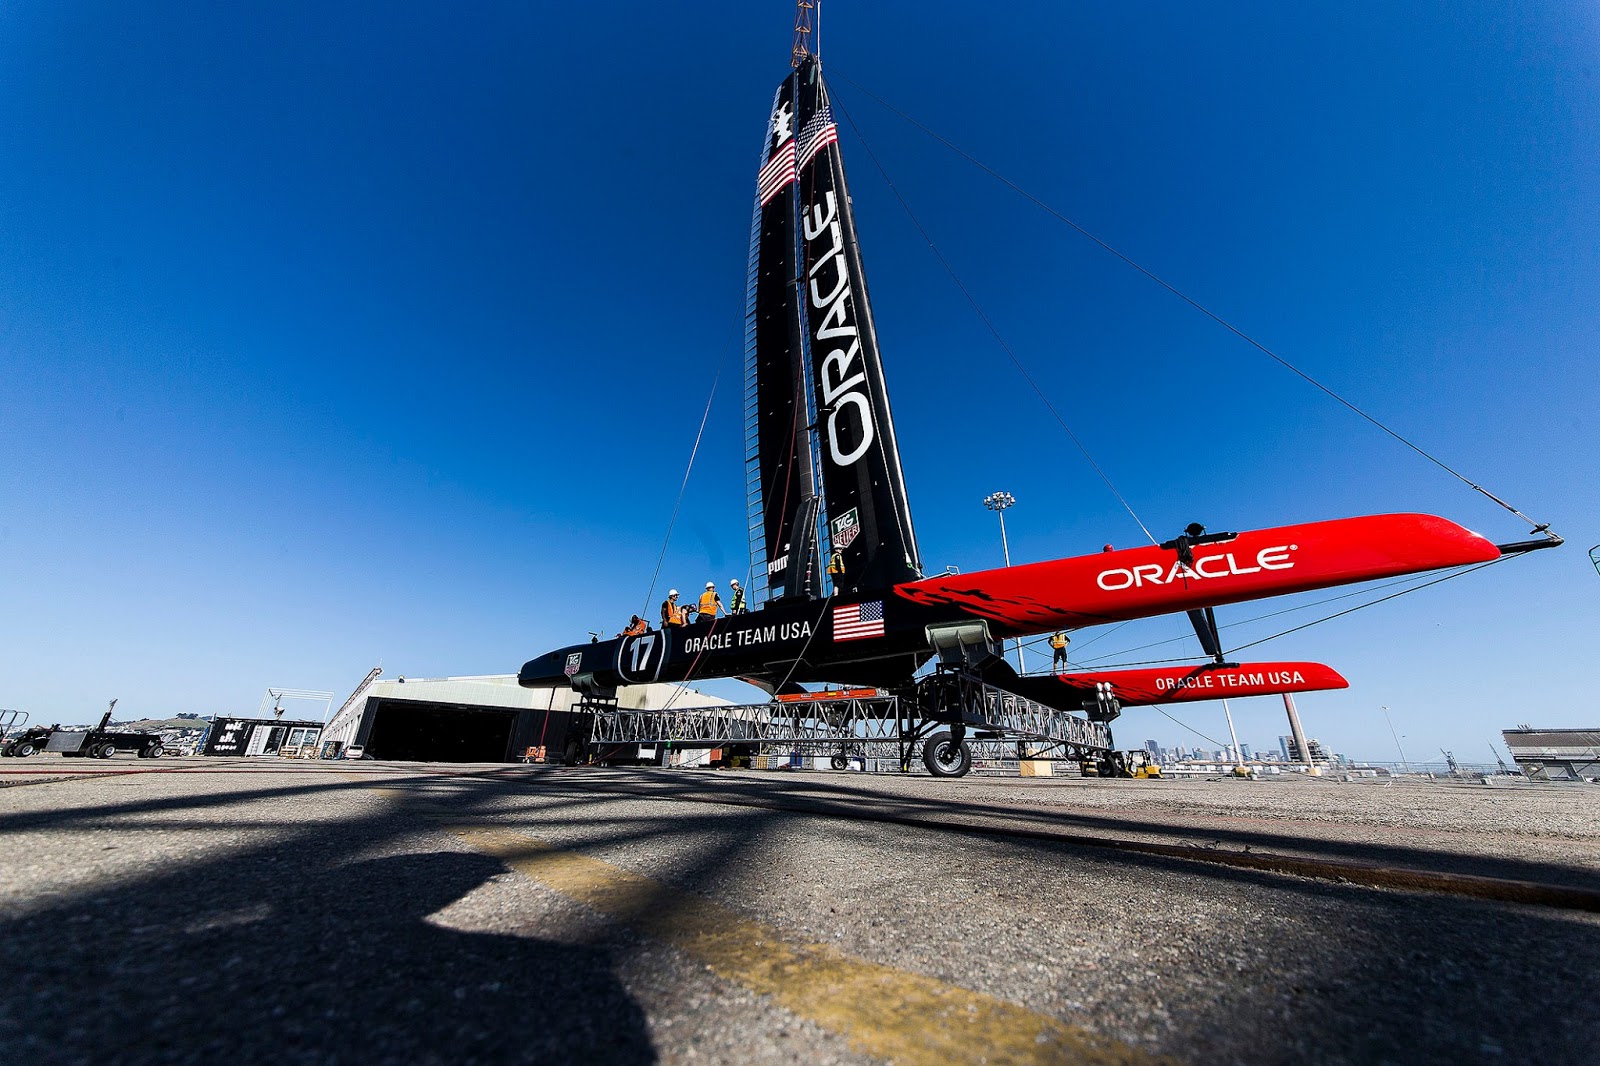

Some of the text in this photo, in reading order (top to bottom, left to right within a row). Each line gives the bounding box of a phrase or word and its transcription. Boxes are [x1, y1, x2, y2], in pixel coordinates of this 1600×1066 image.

[803, 190, 874, 466] ORACLE
[833, 525, 858, 545] HEUER
[835, 513, 854, 532] TAG
[768, 555, 789, 575] PUM
[1096, 545, 1295, 591] ORACLE
[684, 621, 812, 653] ORACLE TEAM USA
[629, 635, 656, 672] 17
[1155, 671, 1305, 690] ORACLE TEAM USA
